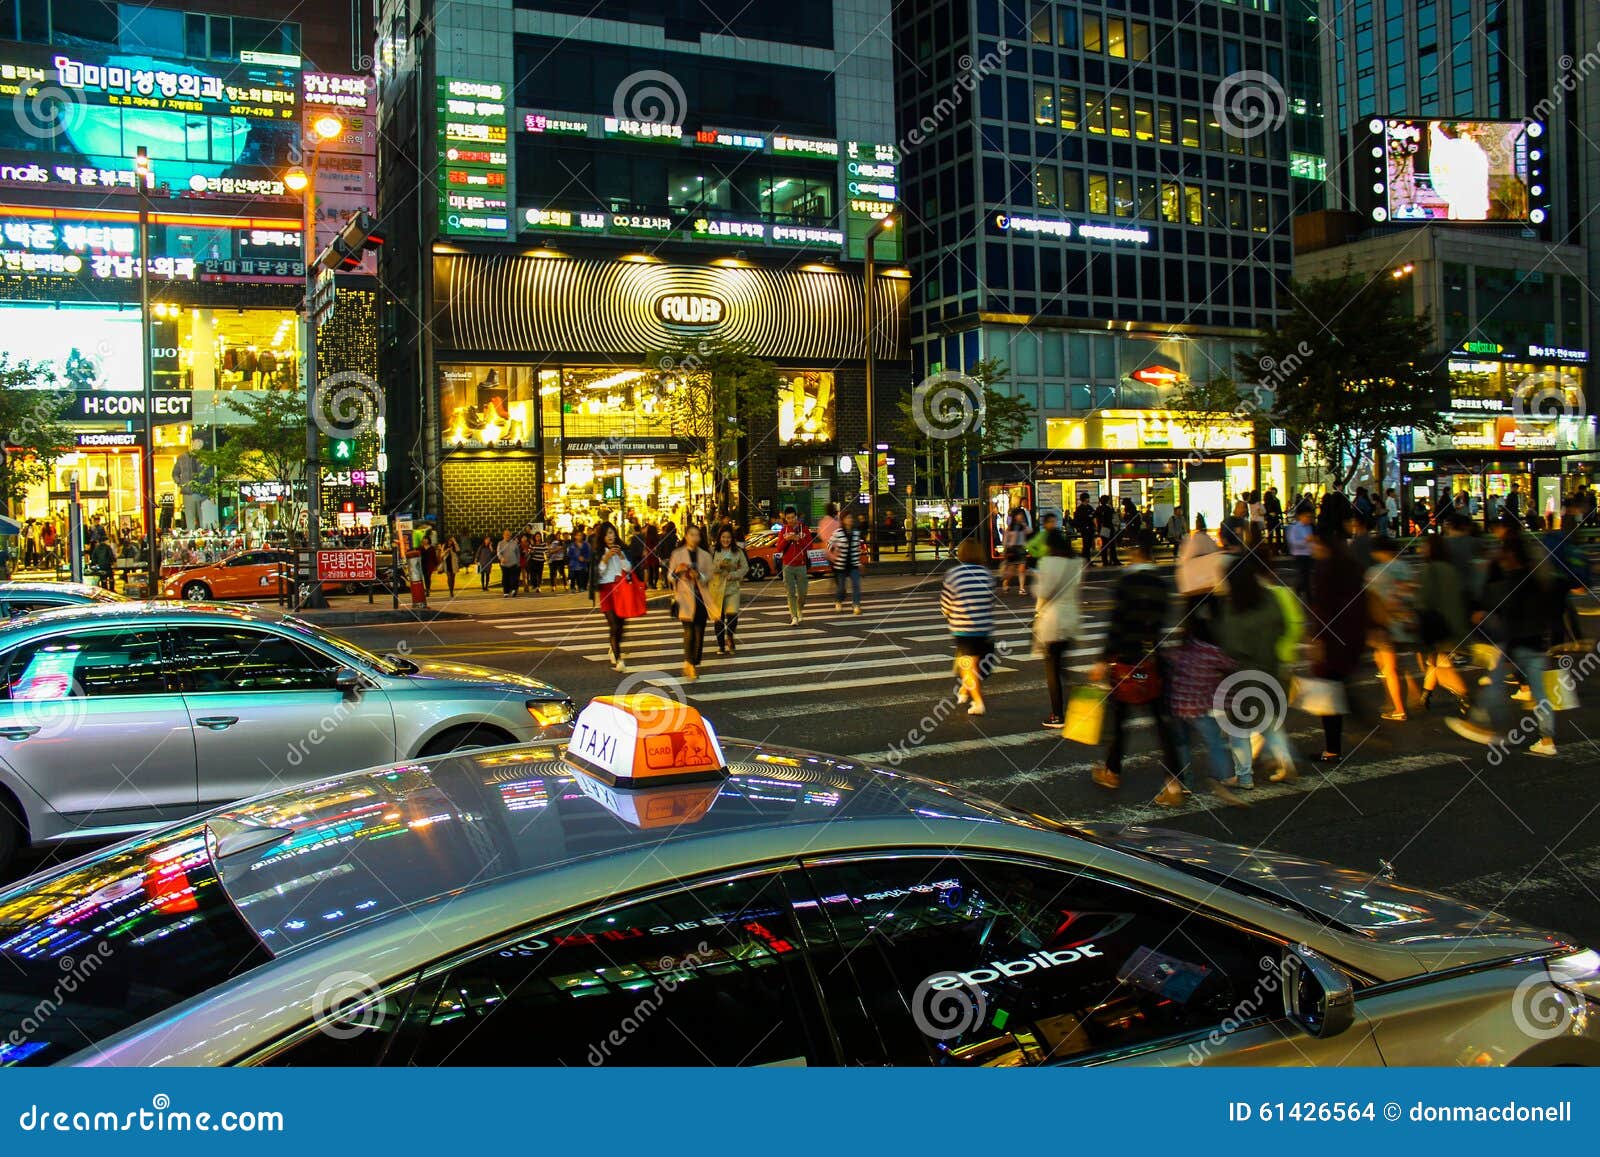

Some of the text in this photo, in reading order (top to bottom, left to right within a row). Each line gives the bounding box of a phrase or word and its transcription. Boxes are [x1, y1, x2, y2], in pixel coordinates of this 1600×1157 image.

[0, 164, 49, 183] nails
[660, 295, 723, 323] FOLDER
[83, 396, 191, 416] H:CONECT
[579, 724, 617, 765] TAXI
[648, 747, 672, 756] CARD
